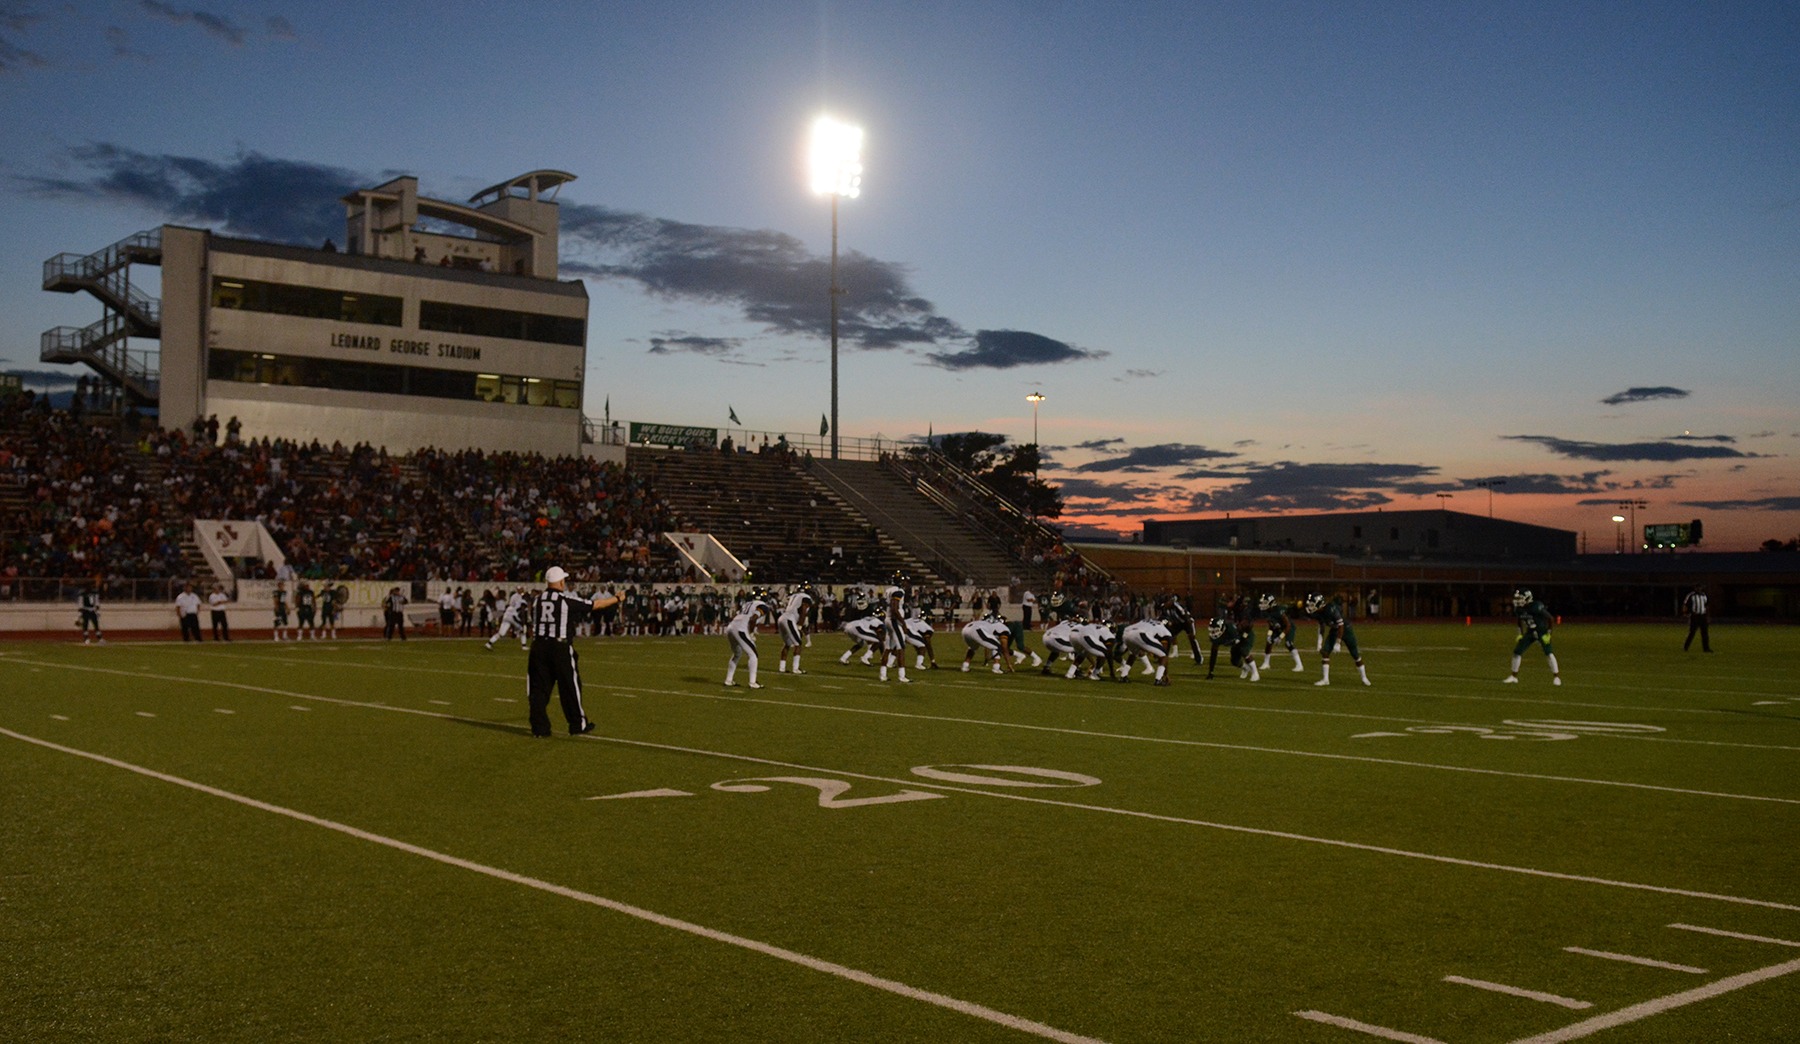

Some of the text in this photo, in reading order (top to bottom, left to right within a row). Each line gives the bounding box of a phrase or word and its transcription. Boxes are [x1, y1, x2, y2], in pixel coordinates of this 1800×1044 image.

[331, 333, 481, 360] LEONARD GEORGE STADIUM
[640, 424, 712, 437] WE BUST OURS
[650, 434, 675, 443] KICK
[540, 601, 555, 622] R
[1404, 719, 1667, 742] 30
[710, 764, 1103, 809] 20
